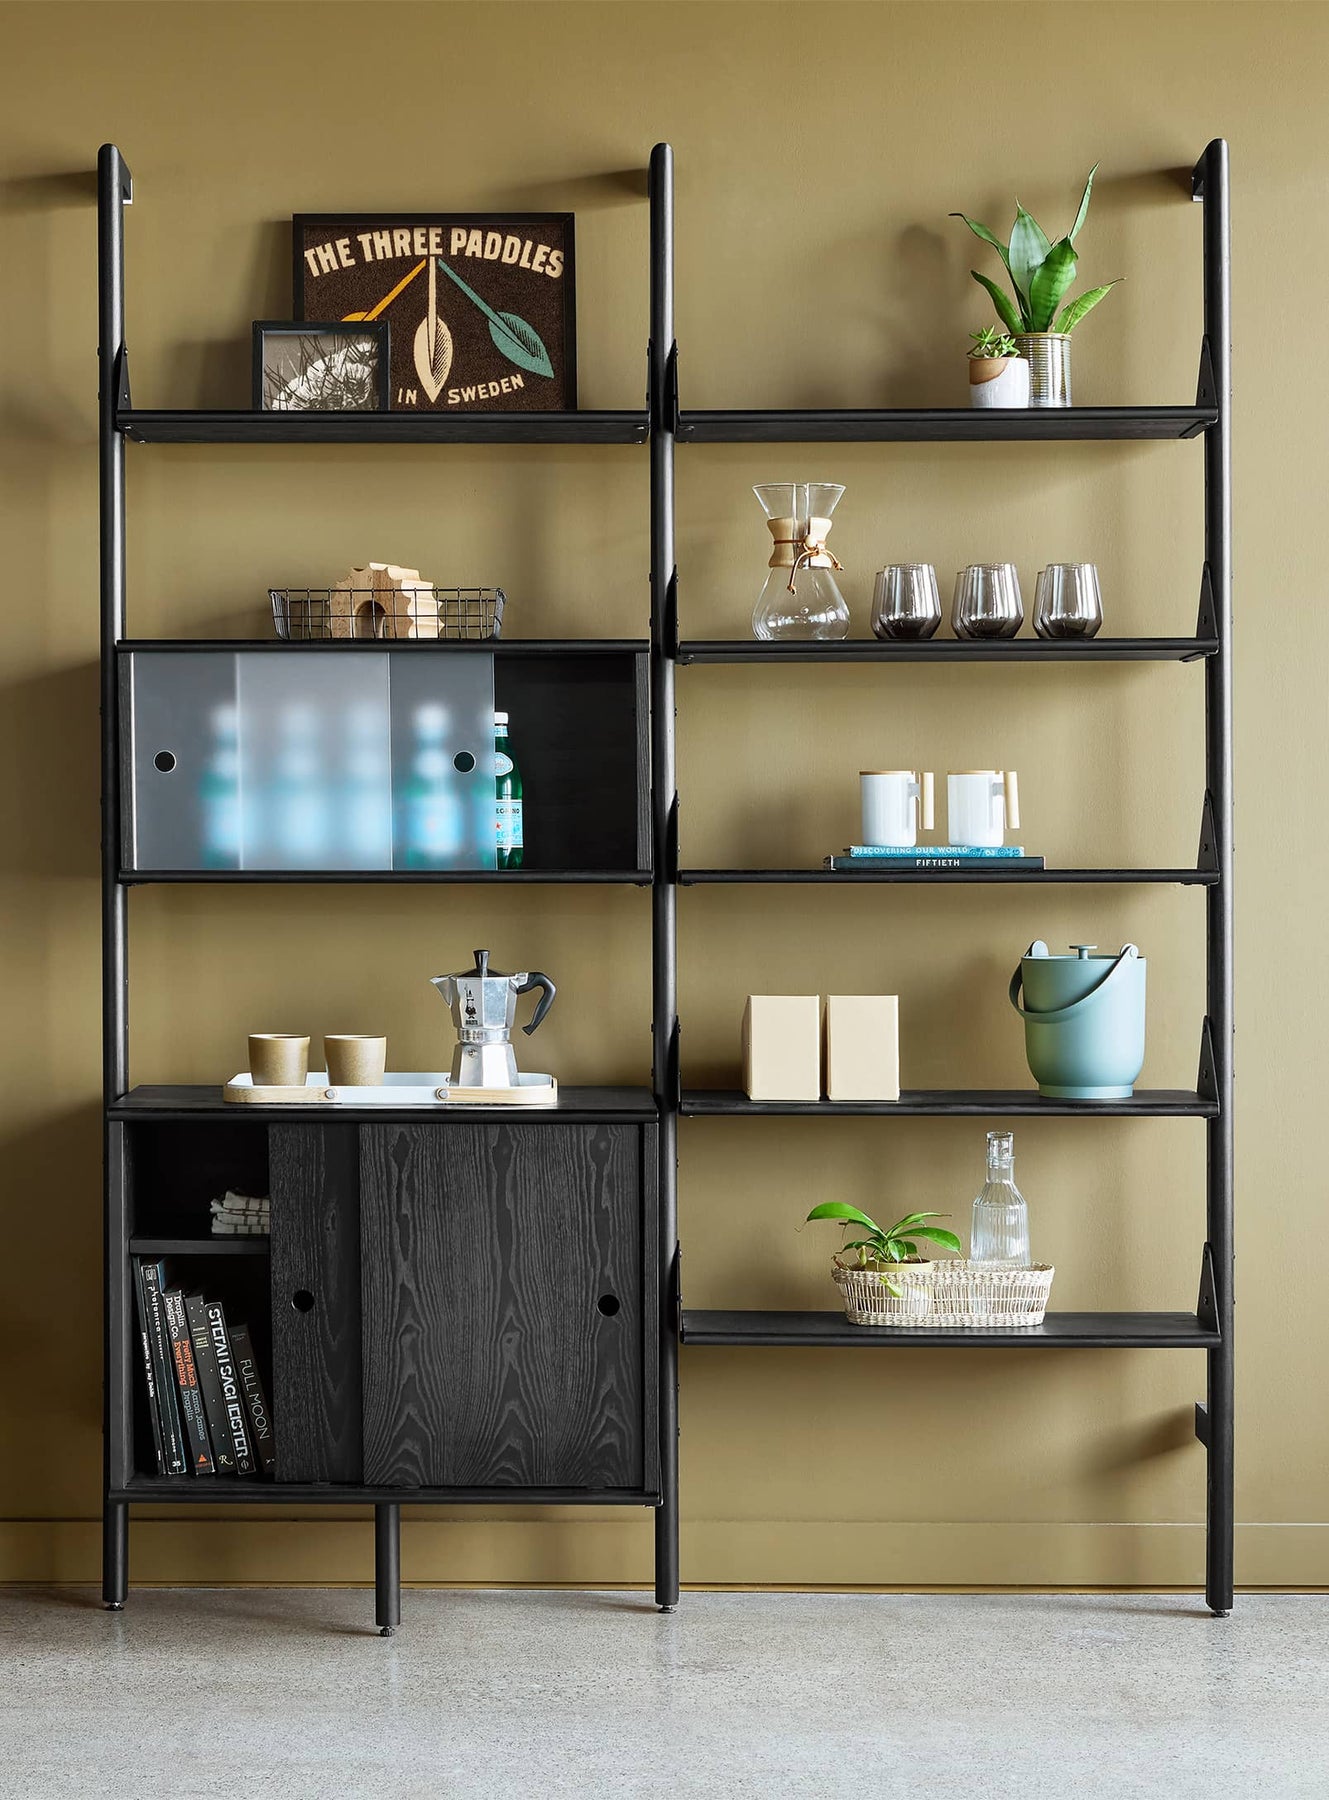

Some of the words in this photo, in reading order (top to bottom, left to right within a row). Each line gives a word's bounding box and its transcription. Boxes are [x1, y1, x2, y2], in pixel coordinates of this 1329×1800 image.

[304, 238, 356, 277] THE
[357, 228, 443, 262] THREE
[451, 228, 564, 278] PADDLES
[397, 388, 417, 405] IN
[447, 374, 525, 405] SWEDEN
[165, 1297, 176, 1326] Design
[174, 1296, 185, 1327] Draplin
[174, 1341, 187, 1386] Everything
[182, 1339, 193, 1363] Pretty
[186, 1363, 197, 1387] Much
[240, 1359, 257, 1392] FULL
[183, 1390, 194, 1421] Draplin
[190, 1389, 201, 1414] Aaron
[196, 1415, 206, 1441] James
[248, 1393, 270, 1440] MOON
